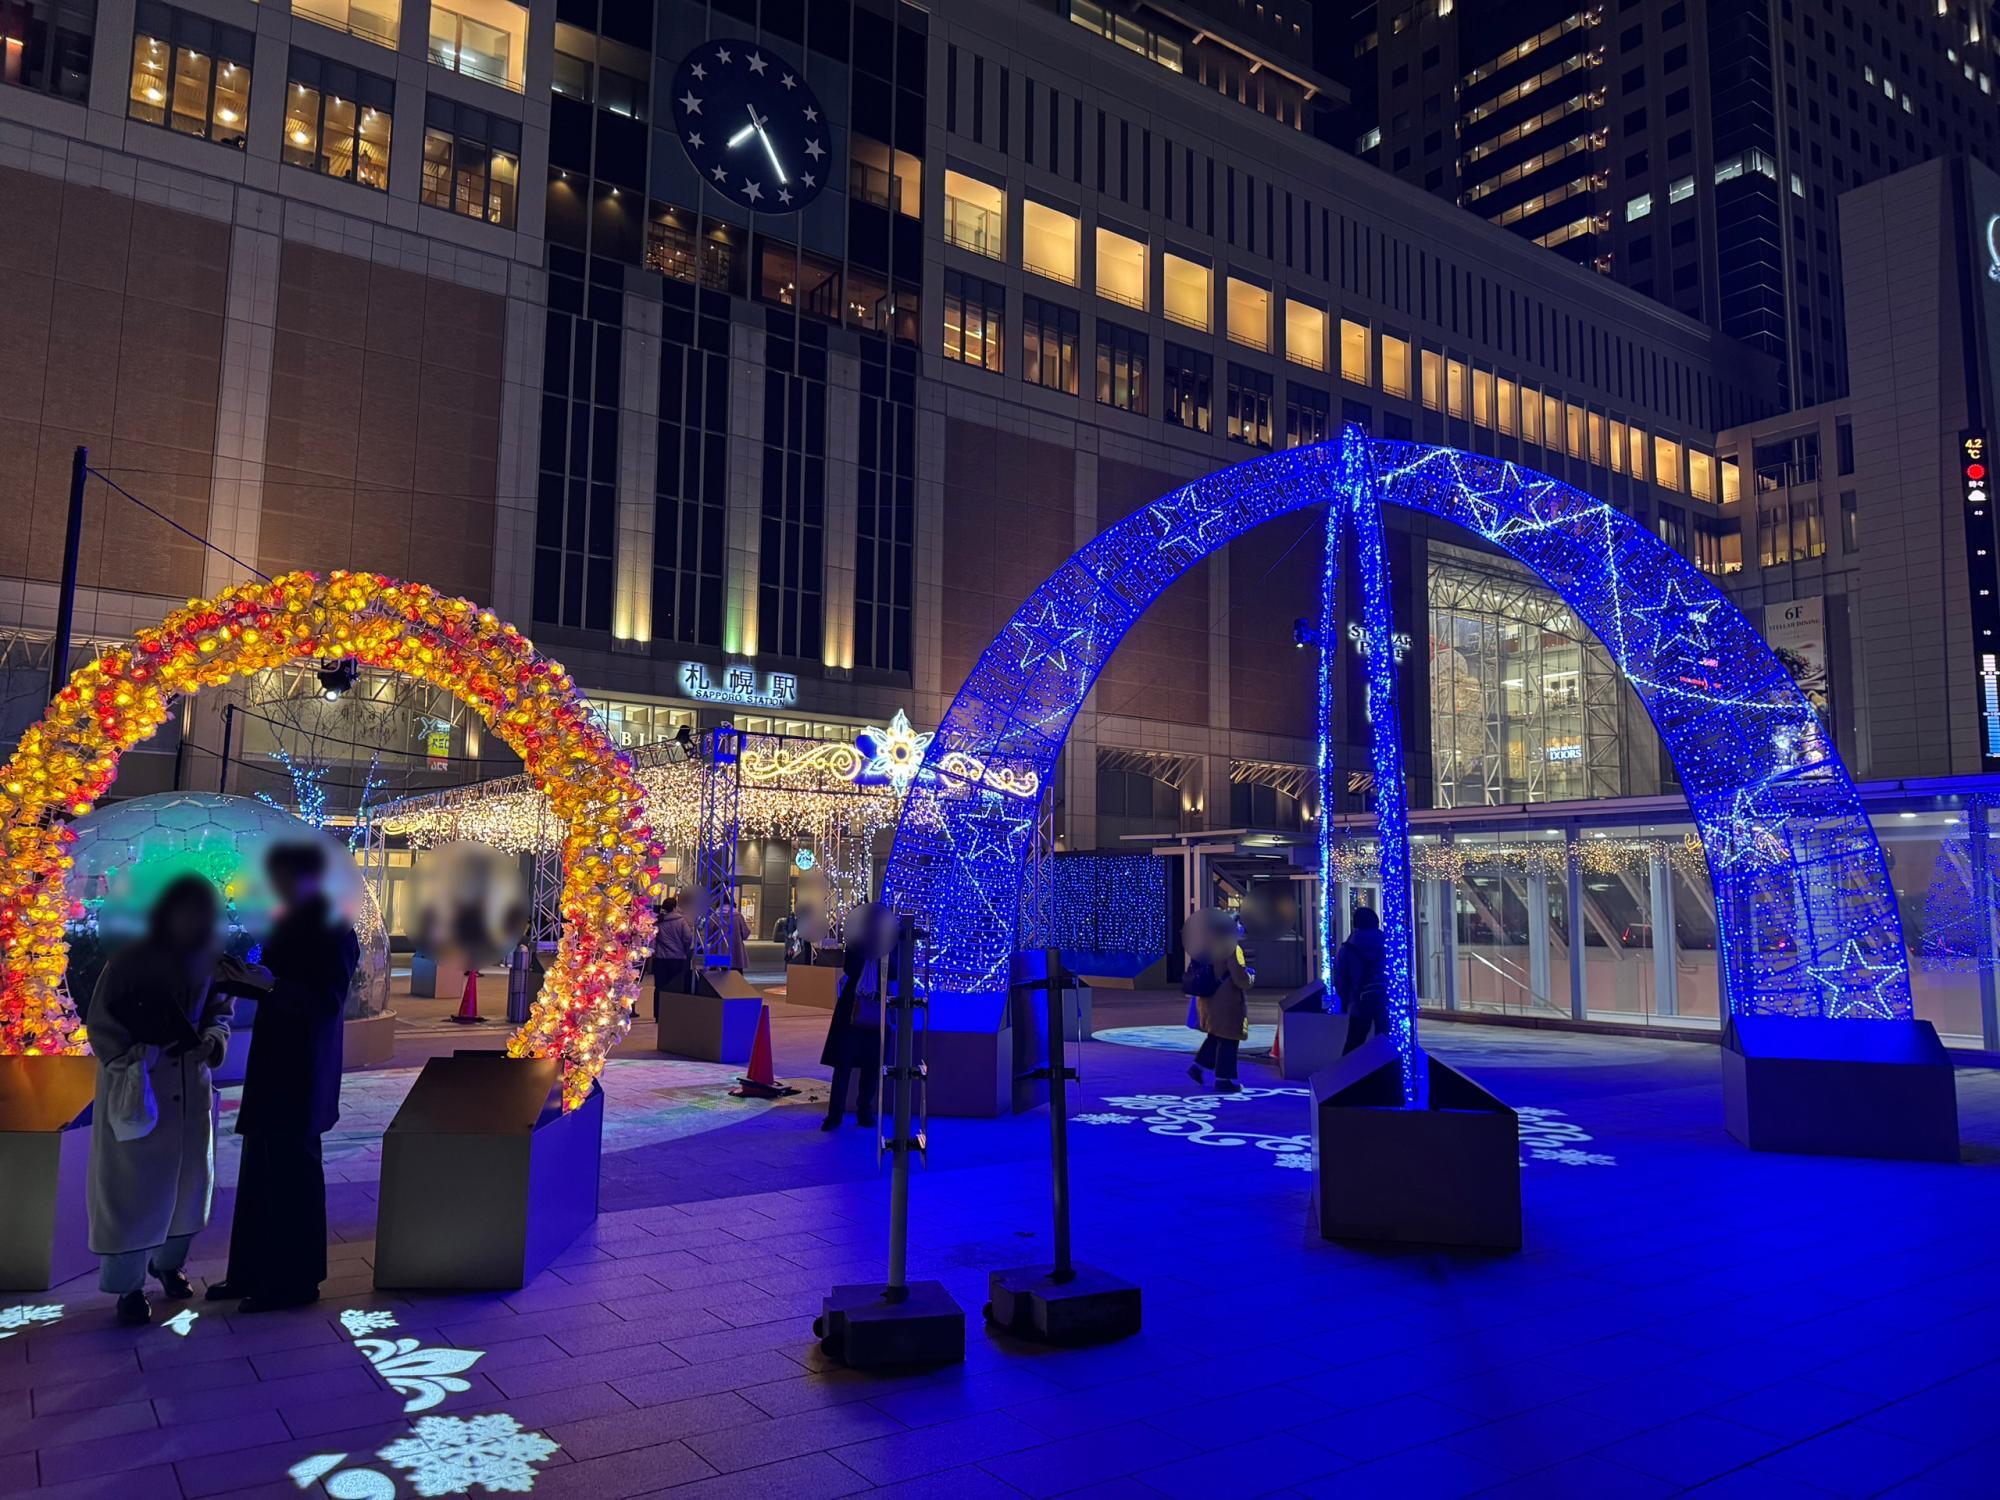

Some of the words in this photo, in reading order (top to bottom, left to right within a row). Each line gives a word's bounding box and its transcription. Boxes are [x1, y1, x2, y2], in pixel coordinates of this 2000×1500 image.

[1965, 438, 1983, 448] 4.2
[1785, 605, 1803, 620] 6F
[685, 663, 796, 701] 札幌駅
[695, 689, 742, 703] SAPPORO
[747, 695, 785, 707] STATION
[1550, 749, 1582, 761] DOORS
